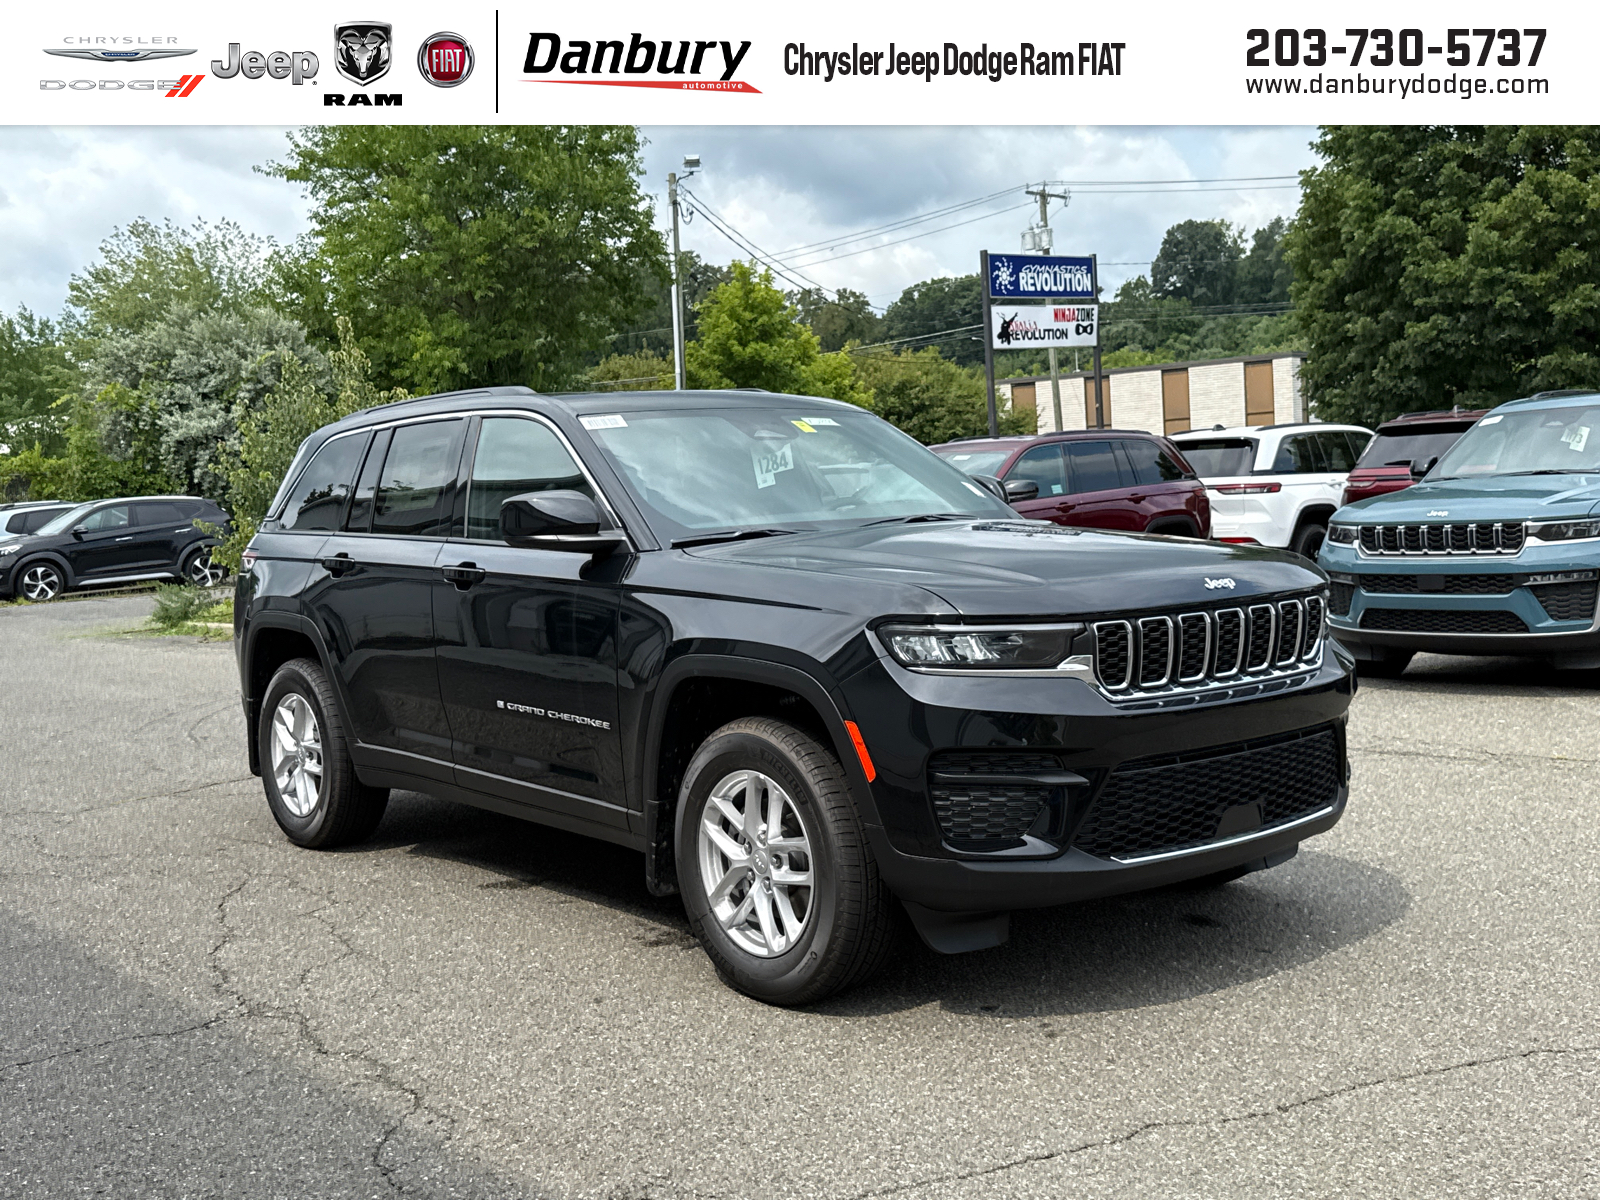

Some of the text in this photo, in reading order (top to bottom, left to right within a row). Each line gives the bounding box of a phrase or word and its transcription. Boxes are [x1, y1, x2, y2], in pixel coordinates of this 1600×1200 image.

[1021, 264, 1088, 274] GYMNASTICS
[1018, 272, 1092, 292] REVOLUTION
[1053, 307, 1095, 323] NINJAZONE
[1009, 327, 1069, 341] REVOLUTION
[757, 451, 789, 475] 1284
[1426, 509, 1449, 518] Jeep
[1204, 577, 1237, 591] Jeep
[506, 701, 611, 731] GRAND CHEROKEE
